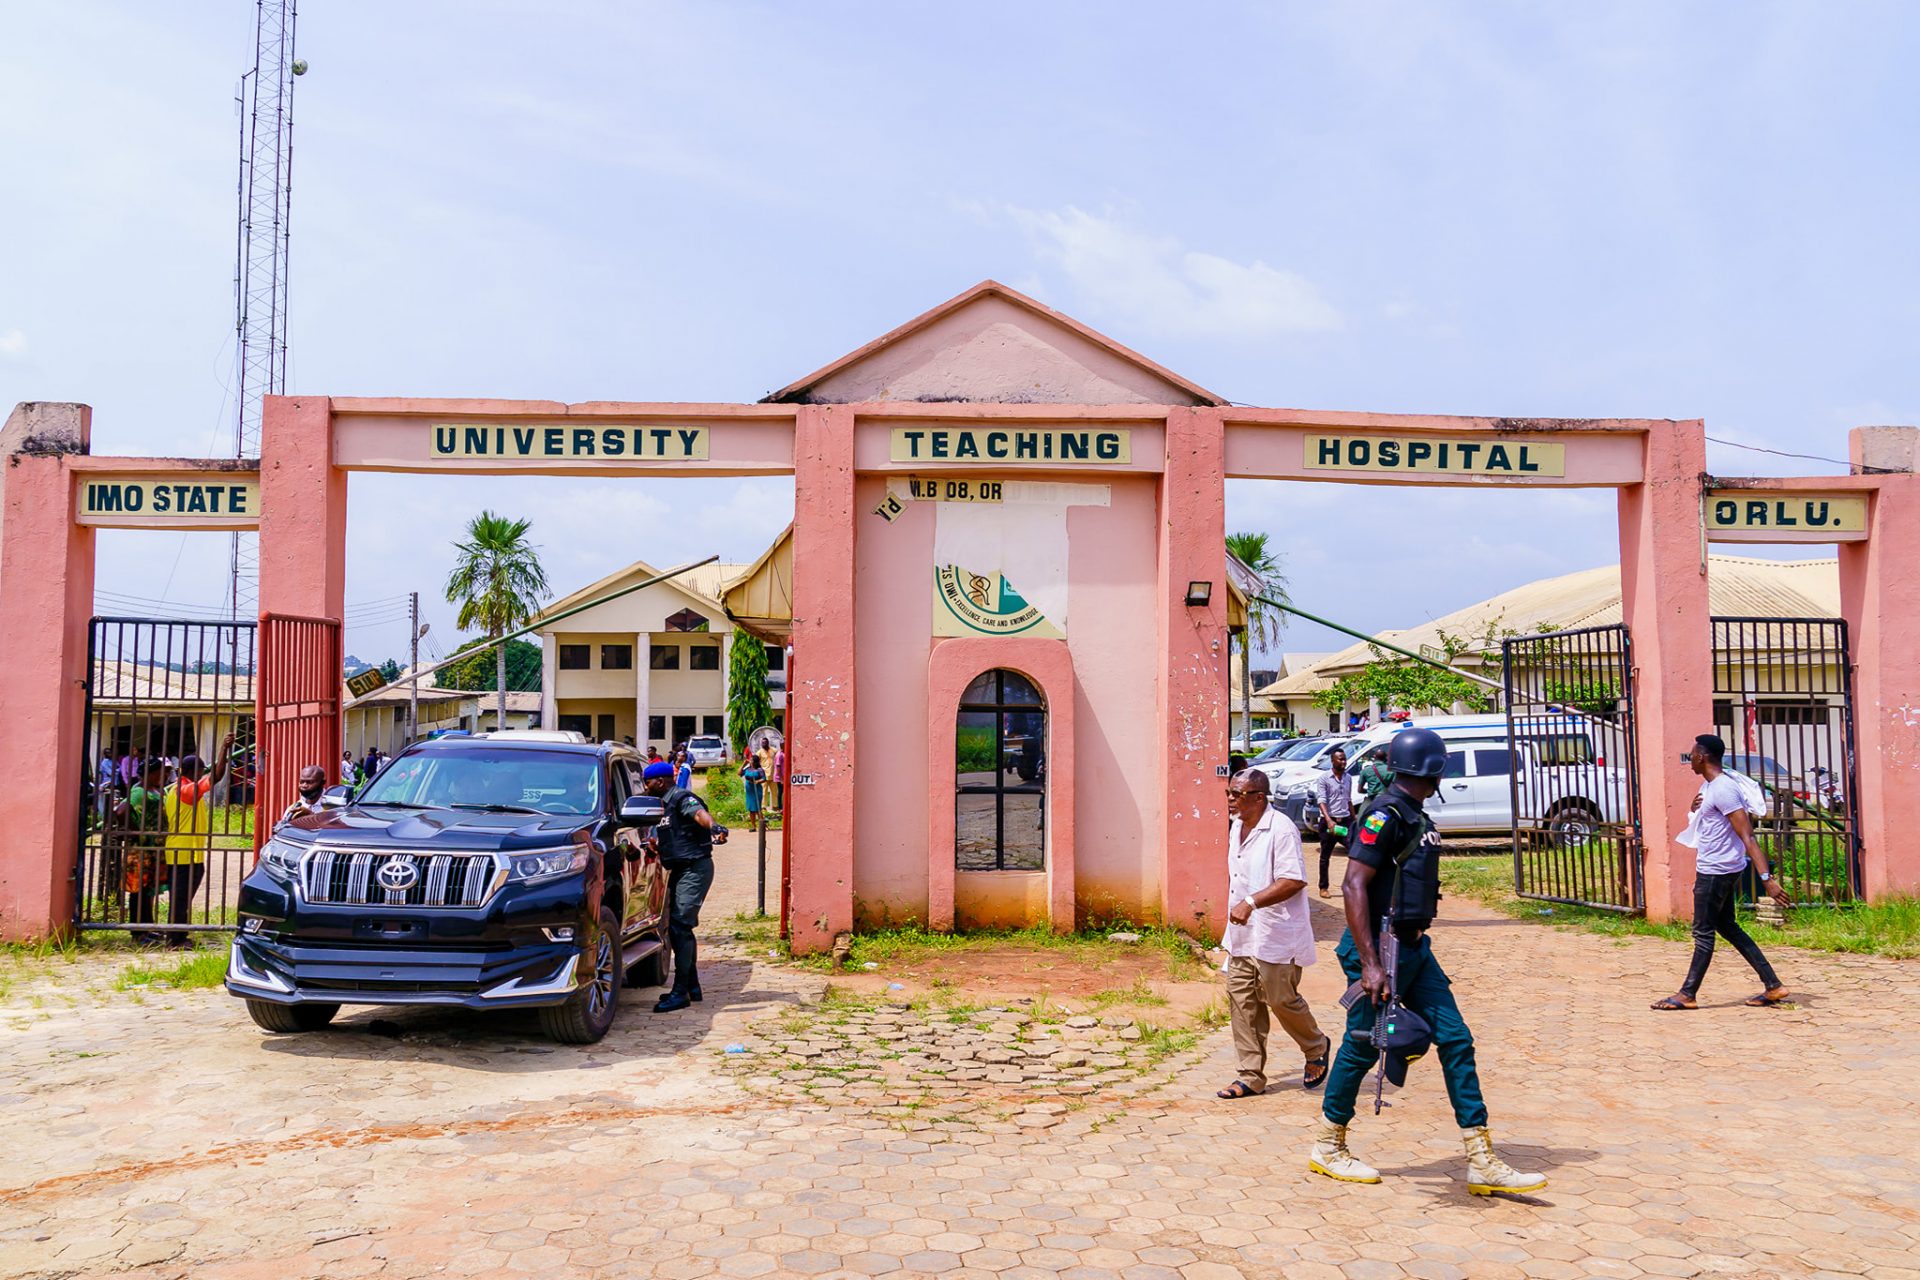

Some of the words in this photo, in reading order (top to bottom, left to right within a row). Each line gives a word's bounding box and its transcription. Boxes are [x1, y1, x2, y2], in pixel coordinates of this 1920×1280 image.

[436, 427, 700, 456] UNIVERSITY
[904, 432, 1120, 459] TEACHING
[1318, 438, 1539, 471] HOSPITAL
[88, 484, 144, 512] IMO
[152, 485, 247, 513] STATE
[946, 481, 974, 501] 08,
[980, 482, 1002, 500] OR
[1715, 500, 1841, 526] ORLU.
[944, 582, 959, 600] IMO
[982, 617, 996, 627] CARE
[997, 618, 1009, 627] AND
[1010, 606, 1039, 626] KNOWLEDGE
[350, 670, 381, 695] STOP
[791, 775, 811, 784] OUT
[1216, 766, 1228, 776] IN
